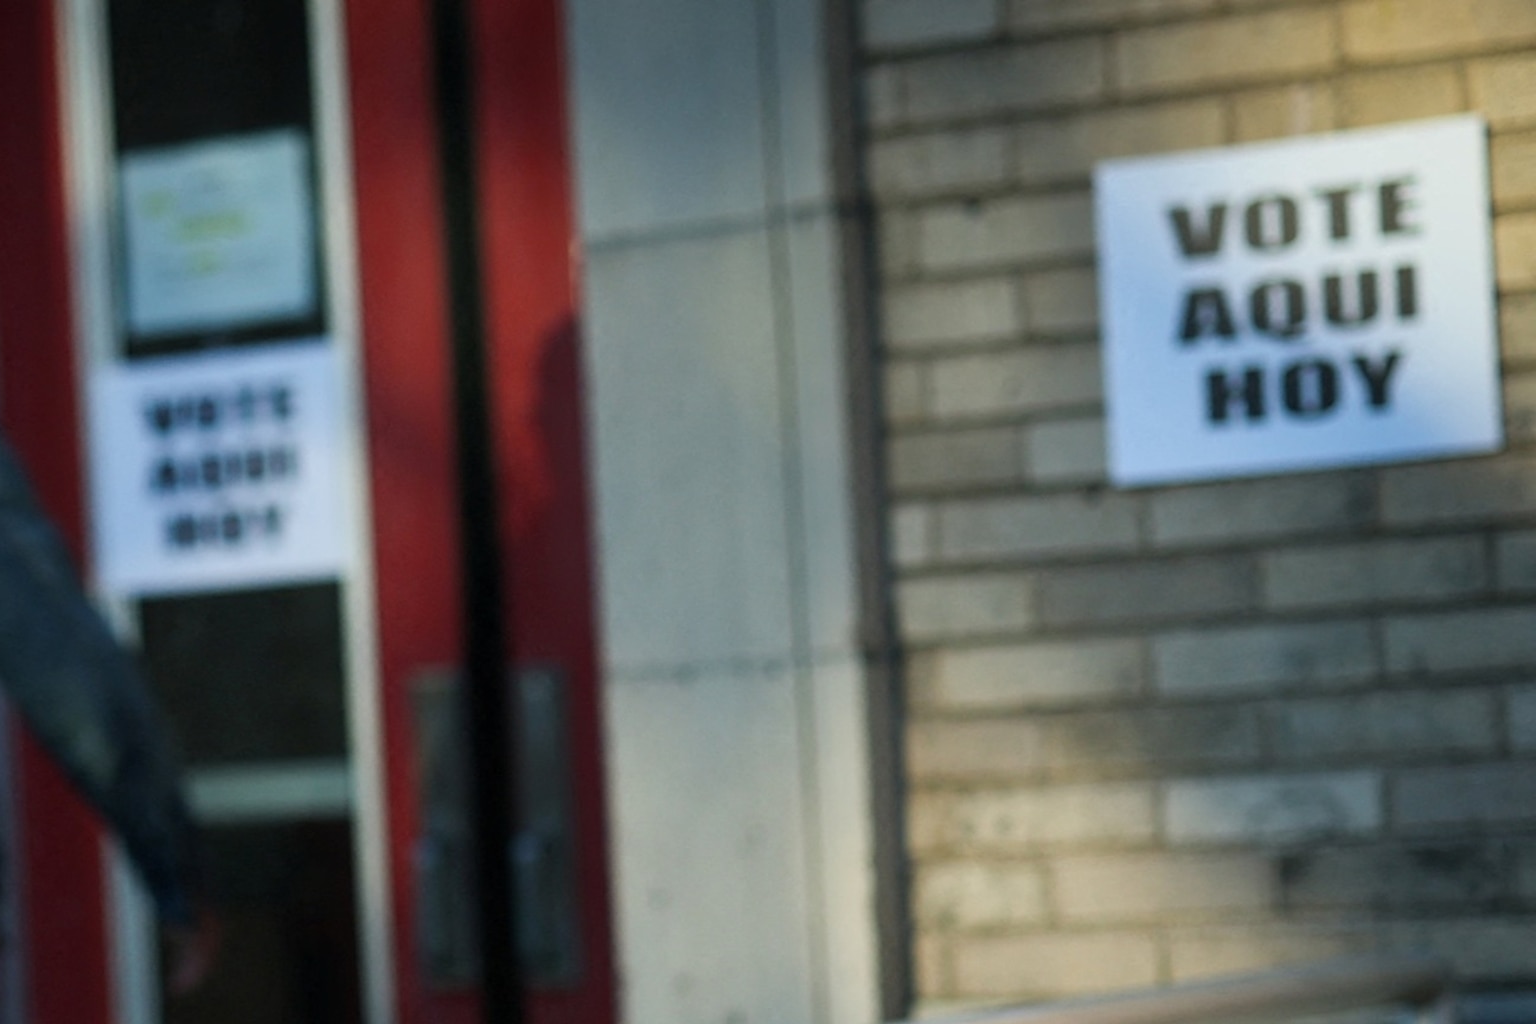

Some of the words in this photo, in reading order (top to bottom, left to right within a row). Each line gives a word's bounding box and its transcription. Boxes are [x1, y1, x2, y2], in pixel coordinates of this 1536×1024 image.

[1167, 175, 1423, 257] VOTE
[1177, 264, 1419, 343] AQUI
[1205, 351, 1402, 424] HOY
